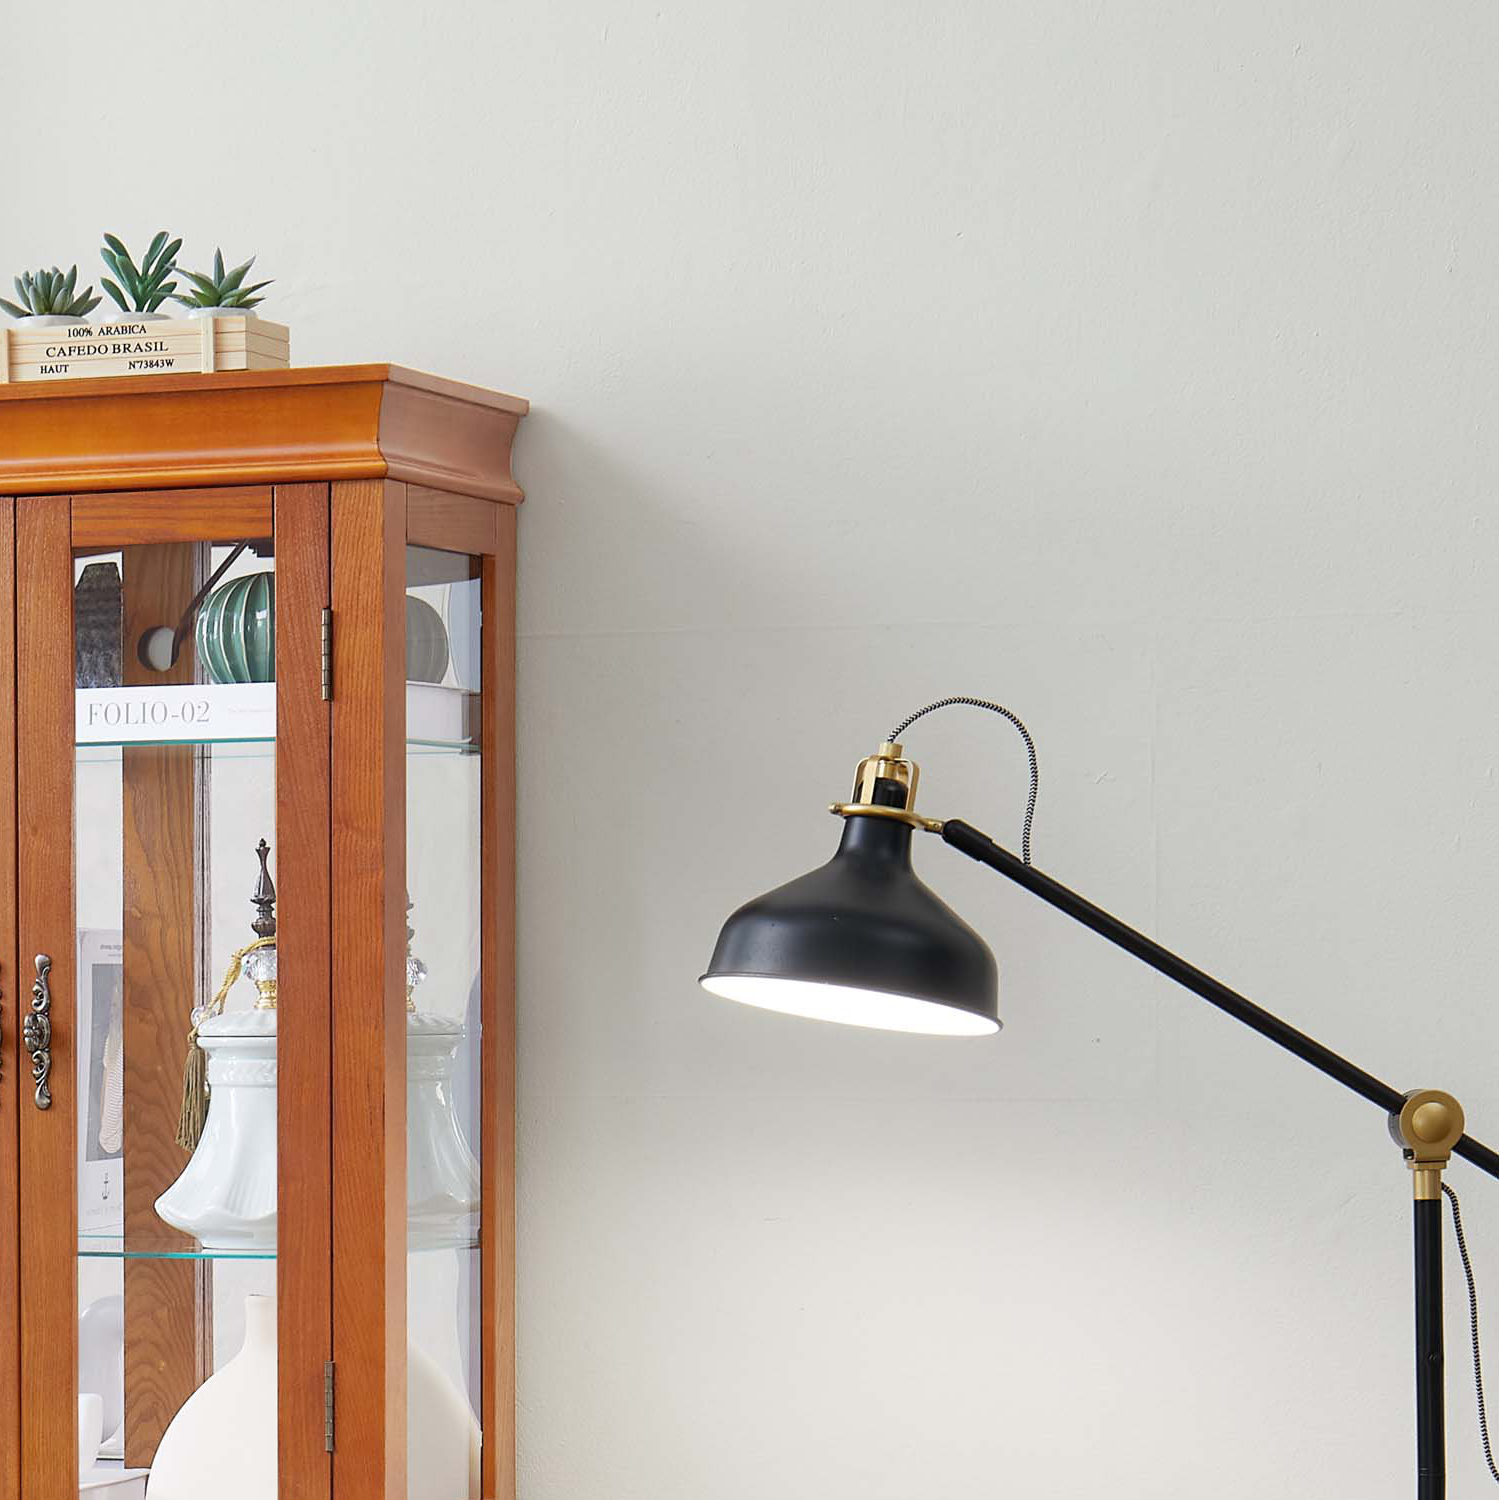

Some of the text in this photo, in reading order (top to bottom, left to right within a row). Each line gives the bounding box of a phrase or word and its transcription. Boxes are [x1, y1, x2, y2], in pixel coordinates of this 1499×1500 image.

[67, 324, 147, 338] 100% ARABICA
[111, 341, 169, 355] BRASIL
[40, 364, 70, 375] HAUT
[87, 700, 210, 726] FOLIO-02
